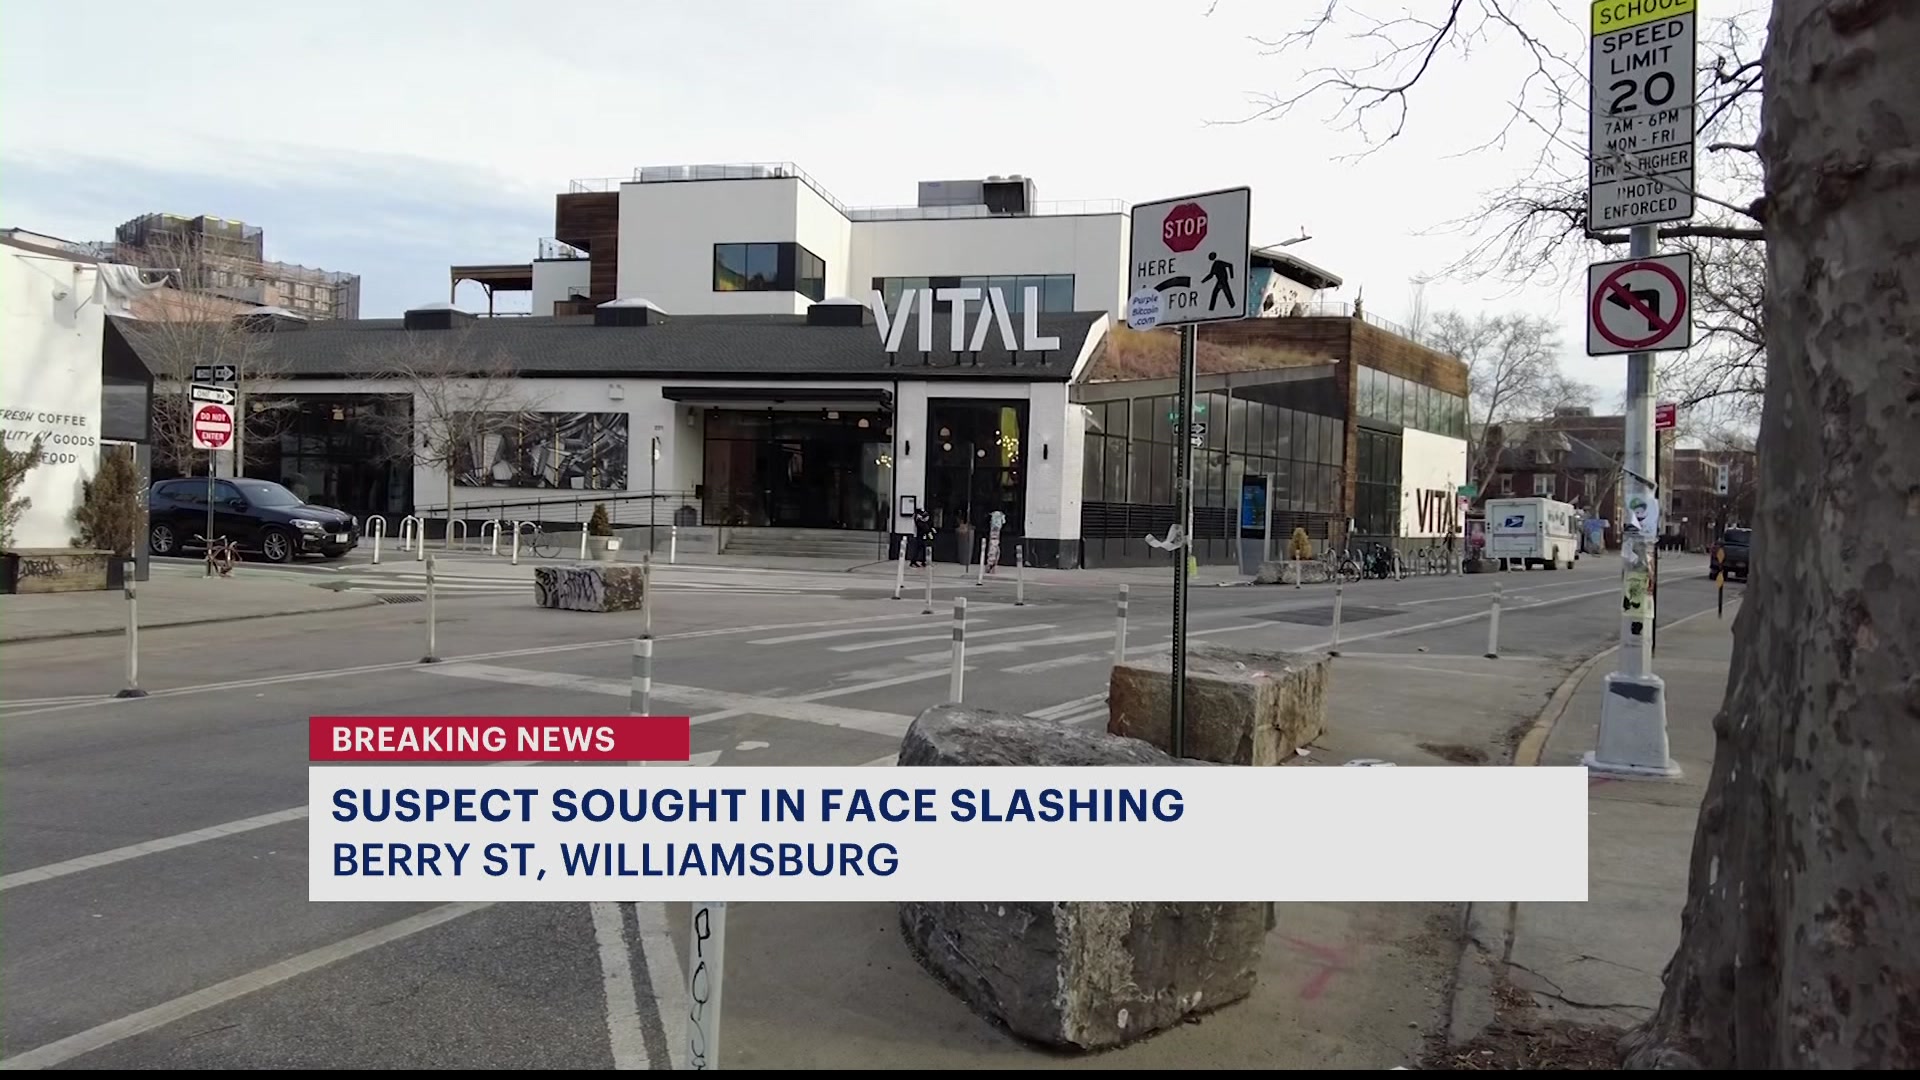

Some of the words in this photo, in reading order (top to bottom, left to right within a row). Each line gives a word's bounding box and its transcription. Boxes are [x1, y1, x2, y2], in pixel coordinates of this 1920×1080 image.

[1602, 20, 1684, 54] SPEED
[1611, 45, 1673, 75] LIMIT
[1609, 71, 1675, 114] 20
[1604, 119, 1633, 136] 7AM
[1648, 108, 1680, 127] 6PM
[1606, 135, 1637, 152] MON
[1652, 128, 1675, 145] FRI
[1595, 161, 1632, 178] FINS
[1639, 150, 1689, 170] HIGHER
[1604, 197, 1678, 220] ENFORCED
[1164, 215, 1207, 240] STOP
[1137, 257, 1177, 278] HERE
[1168, 290, 1199, 310] FOR
[870, 286, 1060, 352] VITAL
[38, 412, 86, 427] COFFEE
[200, 411, 211, 421] DO
[211, 413, 226, 422] NOT
[53, 434, 95, 447] GOODS
[201, 431, 224, 440] ENTER
[42, 452, 76, 464] FOOD
[1416, 488, 1462, 534] VITAL
